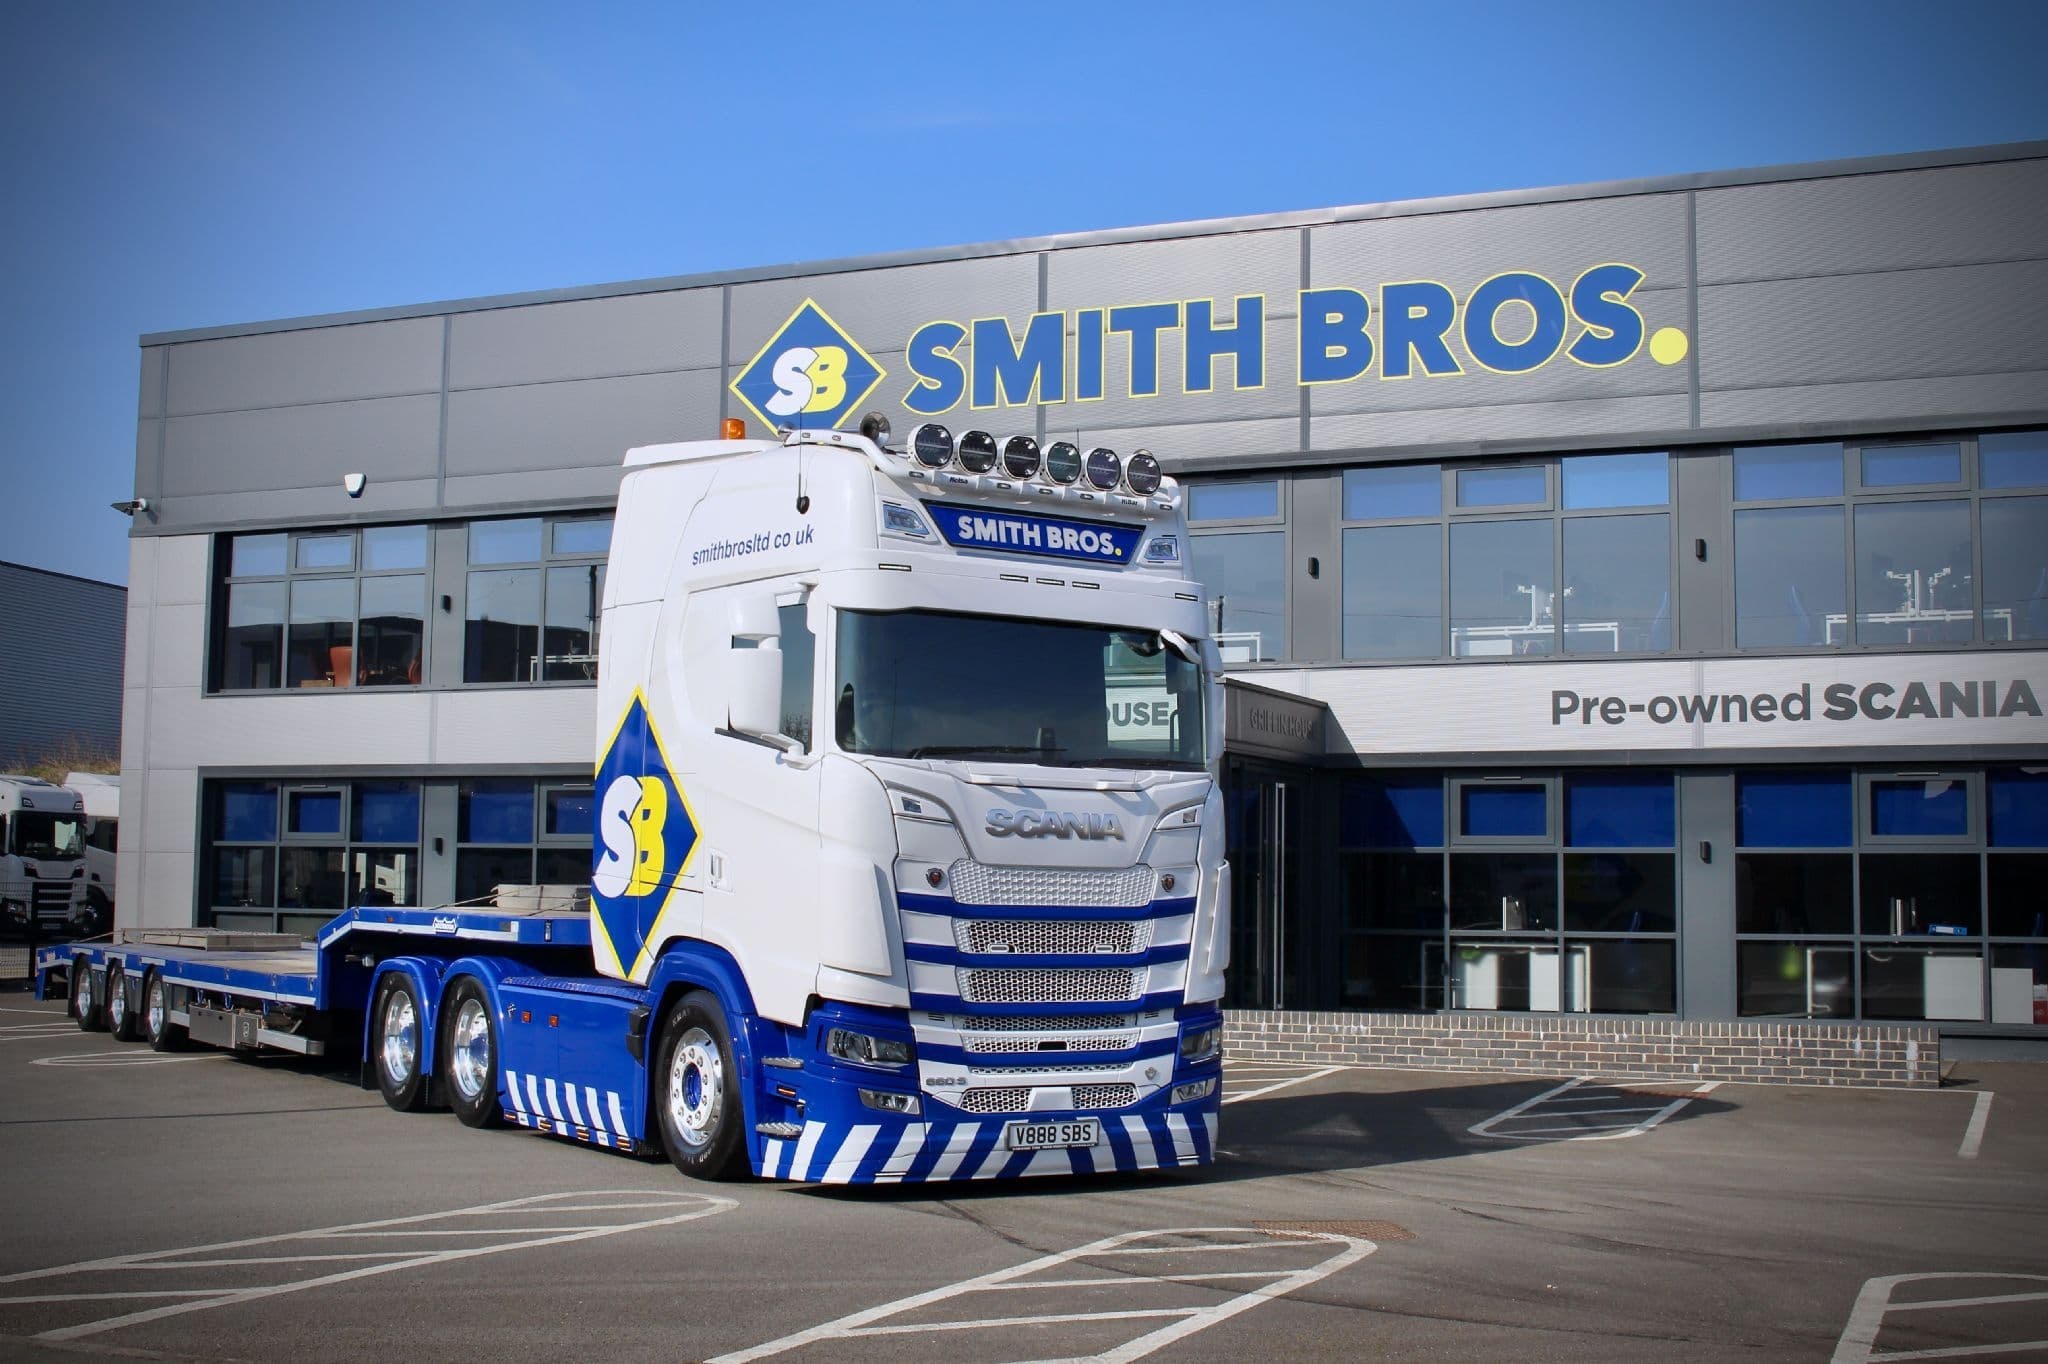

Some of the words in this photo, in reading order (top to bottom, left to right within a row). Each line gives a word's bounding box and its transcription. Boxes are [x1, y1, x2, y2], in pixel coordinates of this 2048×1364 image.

[901, 293, 1265, 416] SMITH
[1297, 263, 1688, 386] BROS.
[765, 346, 848, 416] SB
[692, 531, 770, 565] smithbrosltd
[774, 532, 791, 549] co
[795, 524, 814, 546] uk
[958, 516, 1041, 547] SMITH
[1046, 526, 1122, 556] BROS.
[1107, 702, 1169, 727] USE
[1551, 683, 1810, 725] Pre-owned
[1823, 679, 2043, 721] SCANIA
[592, 775, 668, 899] SB
[985, 808, 1126, 841] SCANIA
[1016, 1125, 1057, 1145] V888
[1061, 1124, 1092, 1143] SBS
